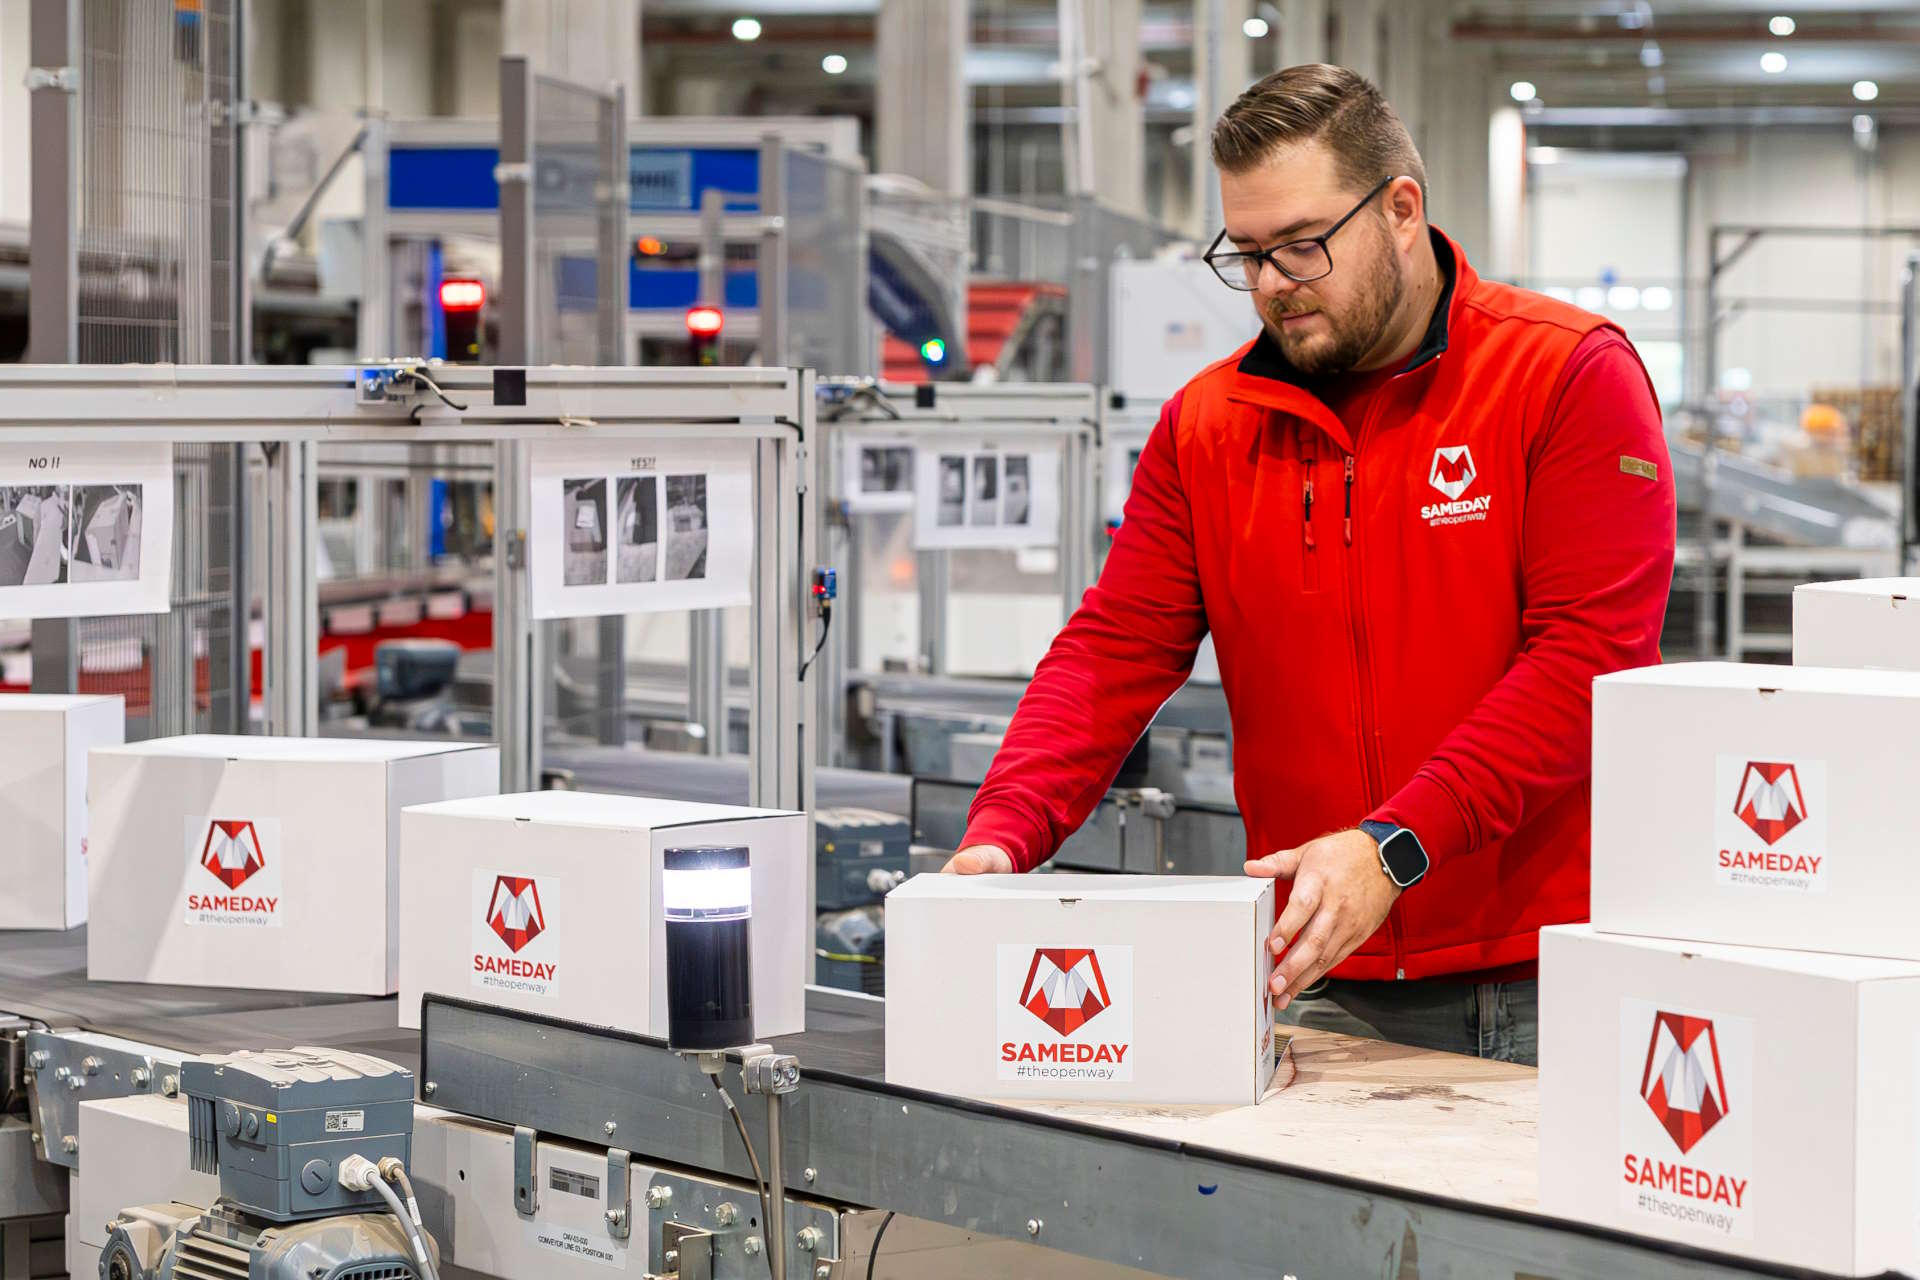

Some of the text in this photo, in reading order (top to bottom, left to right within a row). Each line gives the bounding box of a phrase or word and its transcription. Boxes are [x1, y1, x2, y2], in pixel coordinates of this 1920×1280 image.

[28, 457, 48, 469] NO
[1420, 495, 1491, 519] SAMEDAY
[1718, 849, 1822, 874] SAMEDAY
[188, 894, 278, 913] SAMEDAY
[473, 954, 556, 981] SAMEDAY
[483, 975, 547, 995] #theopenway
[1001, 1042, 1128, 1063] SAMEDAY
[1017, 1065, 1114, 1080] #theopenway
[1623, 1153, 1747, 1208] SAMEDAY
[1638, 1192, 1734, 1233] #theopenway
[537, 1235, 563, 1248] CONVEYOR
[564, 1242, 575, 1252] LINE
[582, 1247, 605, 1259] POSITION
